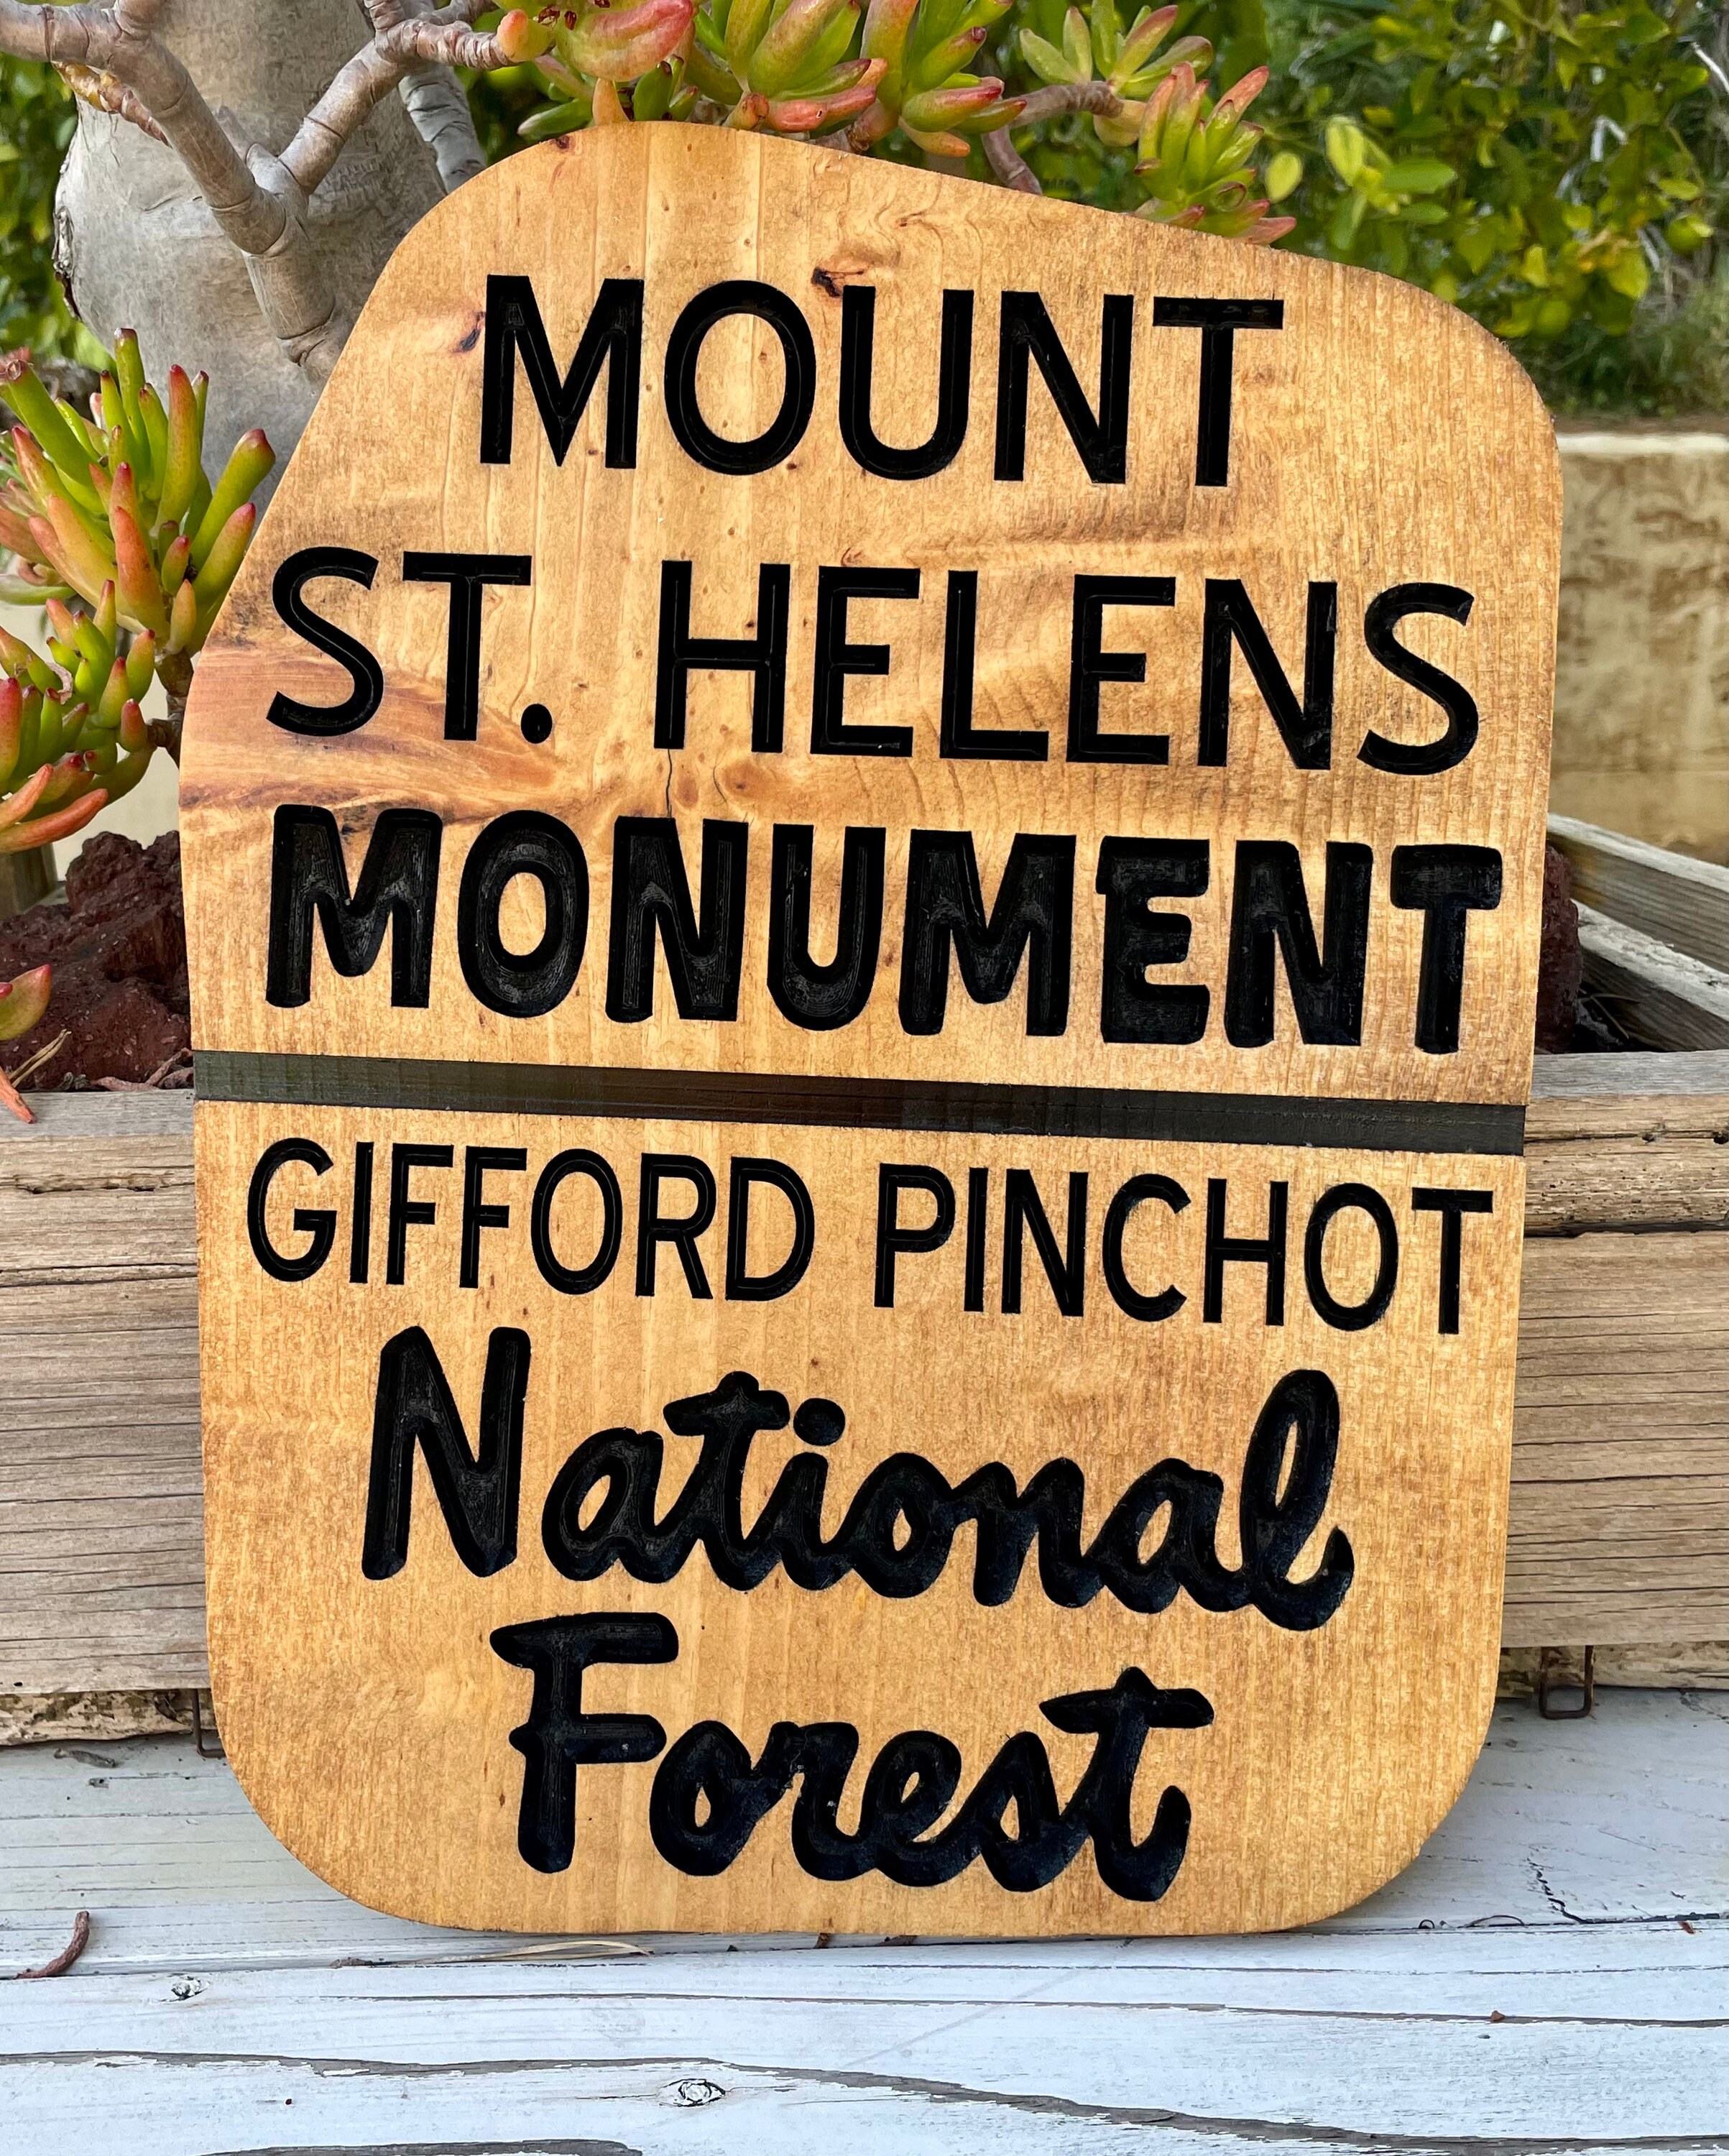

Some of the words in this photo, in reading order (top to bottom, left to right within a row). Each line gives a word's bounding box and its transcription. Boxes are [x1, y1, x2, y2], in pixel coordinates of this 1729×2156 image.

[481, 274, 1283, 487] MOUNT
[266, 547, 552, 744] ST.
[654, 561, 1478, 775] HELENS
[266, 804, 1502, 1052] MONUMENT
[247, 1138, 814, 1301] GIFFORD
[875, 1164, 1493, 1334] PINCHOT
[362, 1325, 1354, 1632] National
[490, 1609, 1214, 1902] Forest
